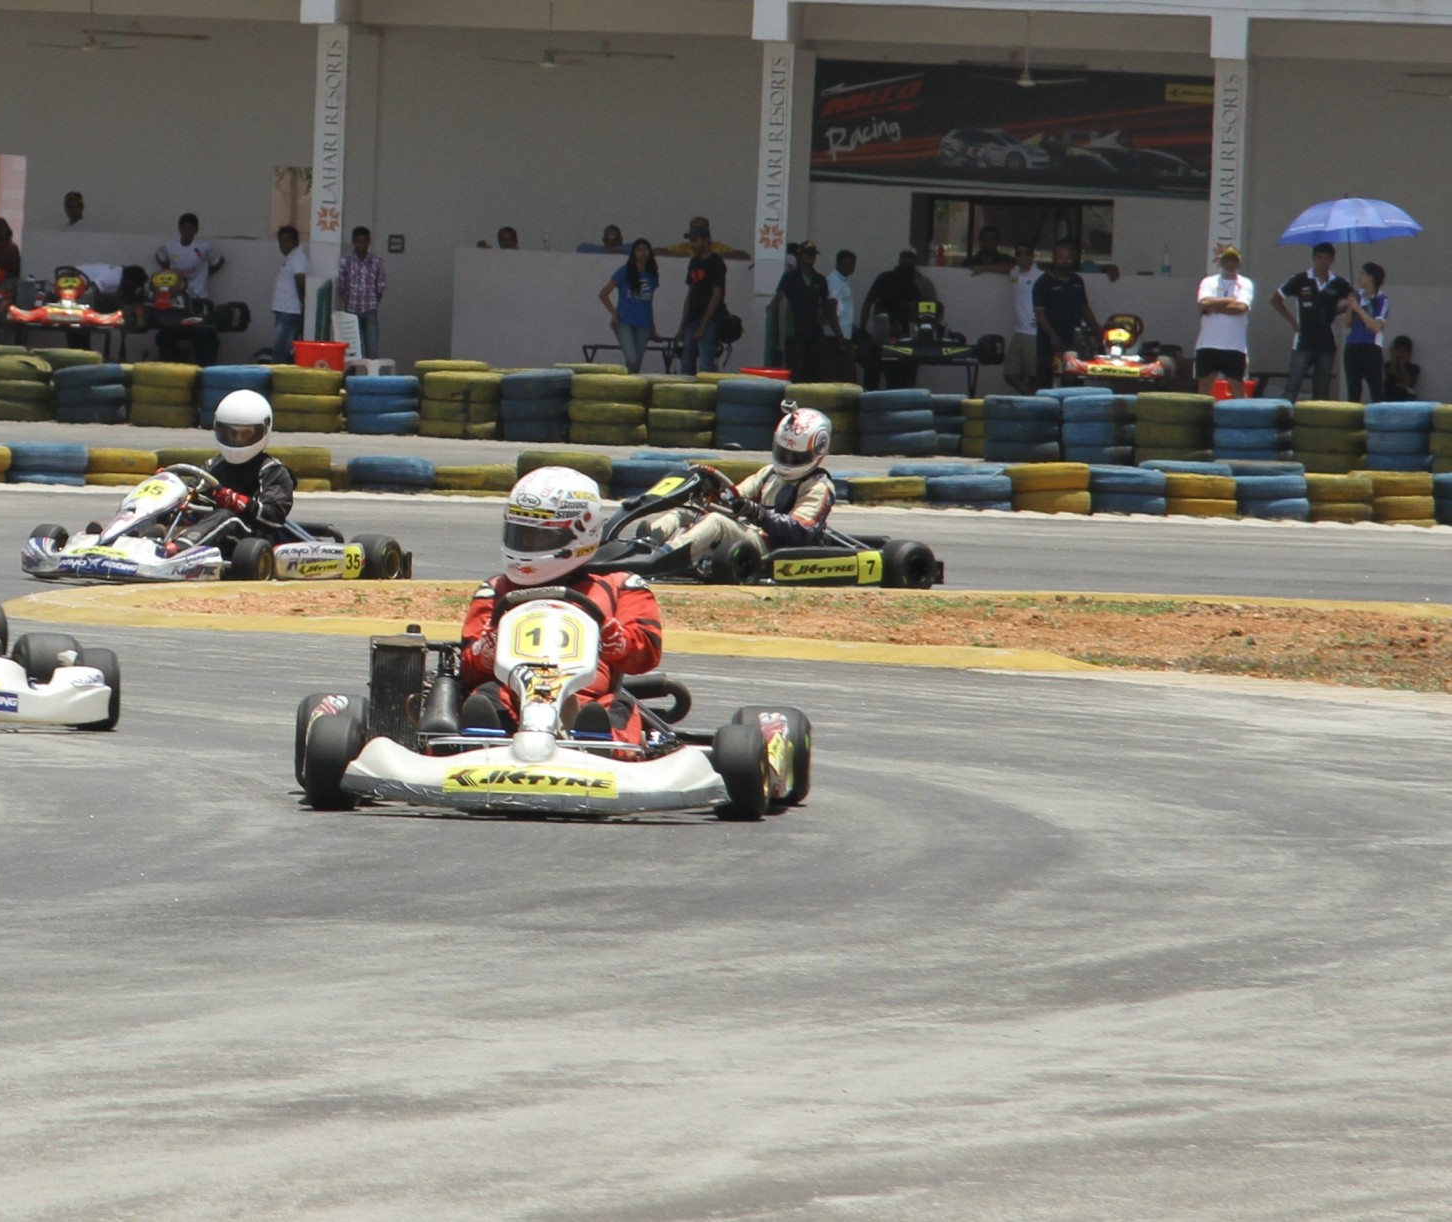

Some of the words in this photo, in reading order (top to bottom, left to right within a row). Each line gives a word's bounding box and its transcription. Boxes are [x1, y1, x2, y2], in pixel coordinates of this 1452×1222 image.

[325, 40, 342, 125] RESORTS
[768, 56, 787, 142] RESORTS
[1221, 74, 1239, 161] RESORTS
[322, 132, 338, 205] LAHARI
[825, 116, 901, 162] Racing
[765, 150, 783, 223] LAHARI
[1218, 168, 1235, 242] LAHARI
[101, 560, 138, 570] RACING
[346, 554, 360, 570] 35
[867, 560, 876, 575] 7
[525, 628, 570, 648] 10
